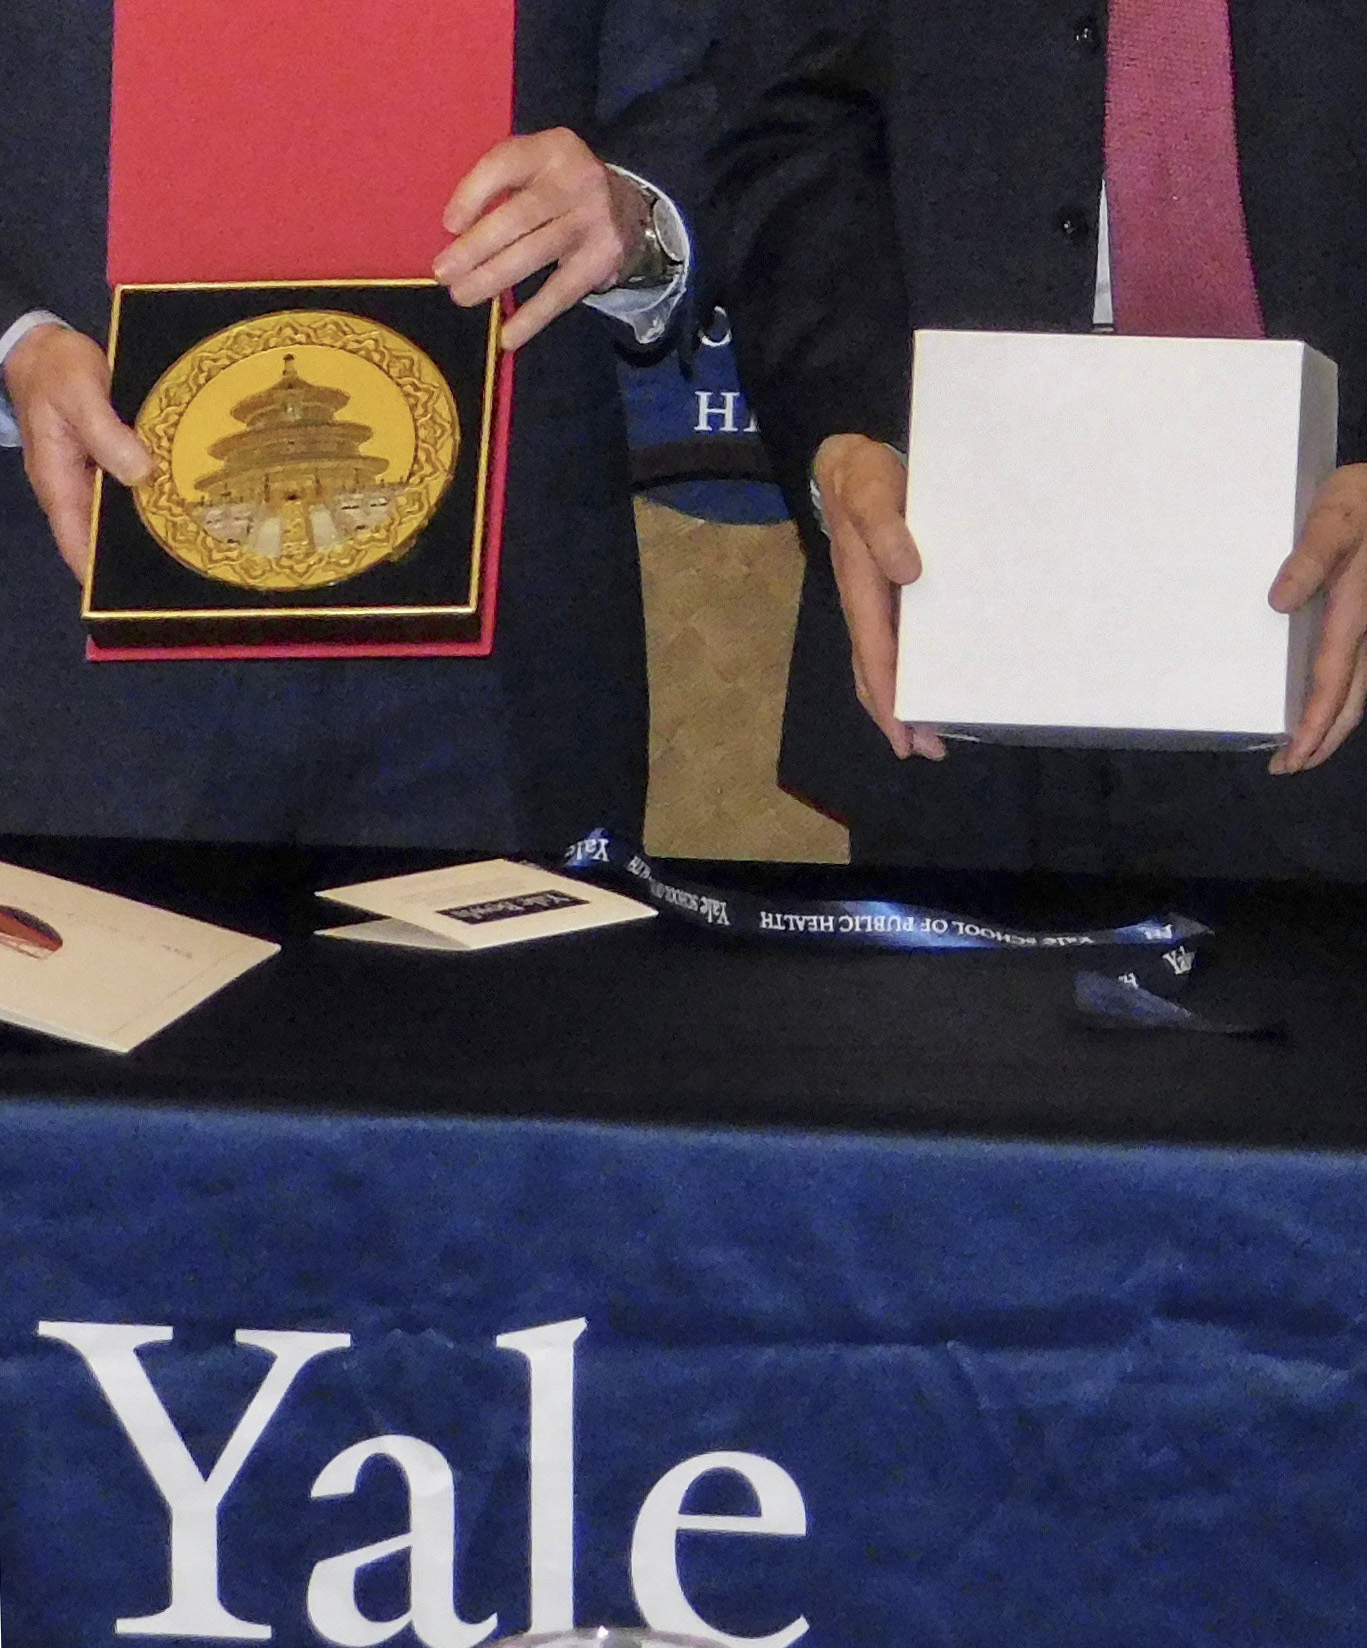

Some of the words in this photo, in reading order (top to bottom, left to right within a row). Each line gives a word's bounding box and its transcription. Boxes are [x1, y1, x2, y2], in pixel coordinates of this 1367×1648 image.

[699, 895, 731, 927] Yale
[759, 910, 835, 933] HEALTH
[838, 913, 916, 933] PUBLIC
[920, 916, 949, 935] OF
[951, 919, 1038, 946] SCHOOL
[36, 1316, 811, 1648] Yale
